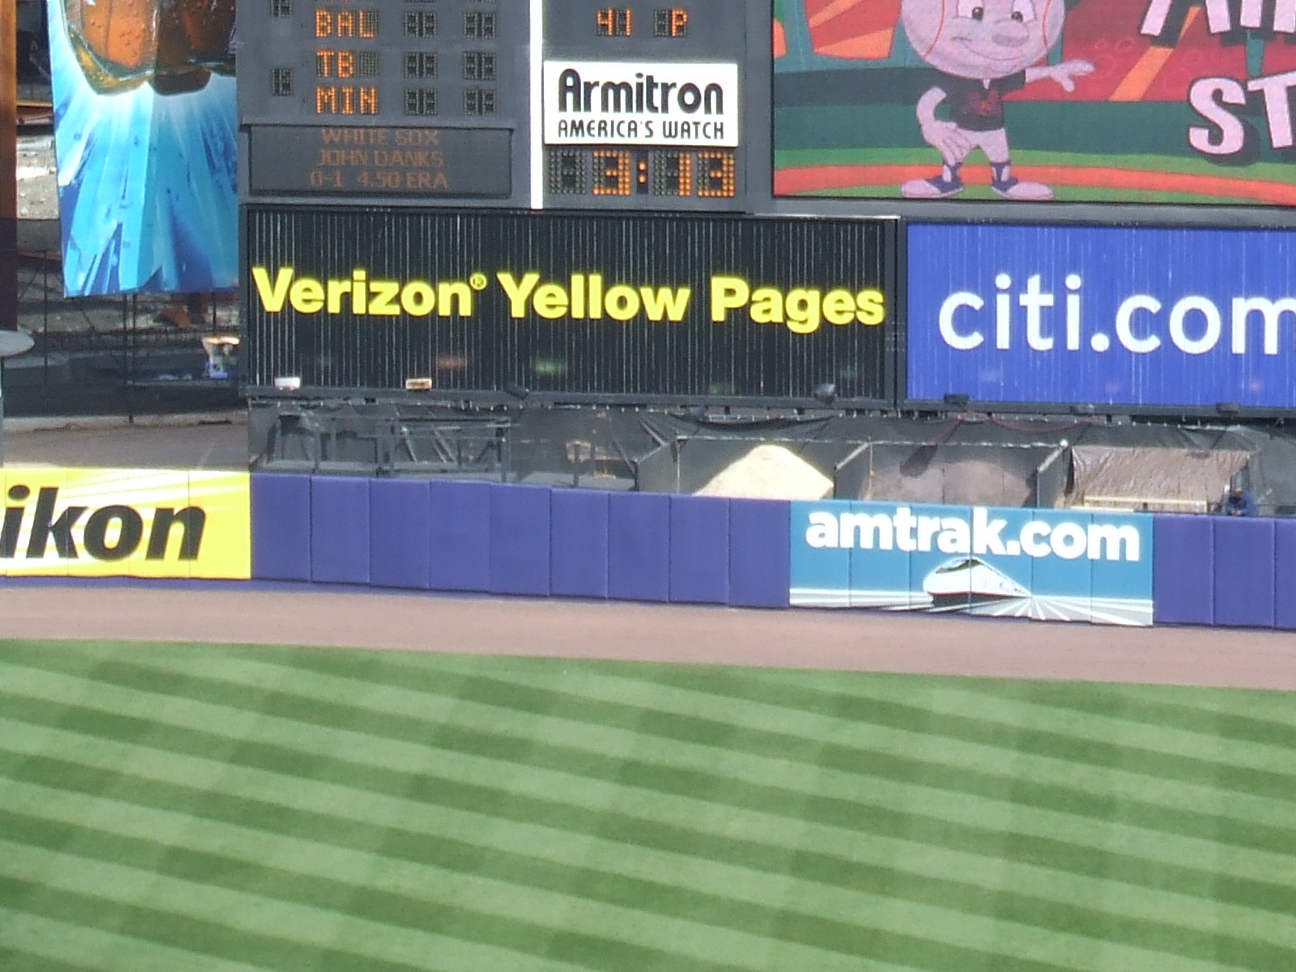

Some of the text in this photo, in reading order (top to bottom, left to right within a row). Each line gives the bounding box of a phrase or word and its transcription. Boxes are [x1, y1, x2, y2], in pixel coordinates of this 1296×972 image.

[316, 9, 374, 38] BAL
[597, 9, 688, 36] 41 P
[317, 49, 355, 78] TB
[316, 87, 377, 114] MIN
[559, 69, 723, 114] Armitron
[559, 120, 723, 138] AMERICA'S WATCH
[593, 149, 736, 199] 3:13
[498, 272, 690, 320] Yellow
[712, 276, 885, 333] Pages
[805, 508, 1141, 562] amtrak.com
